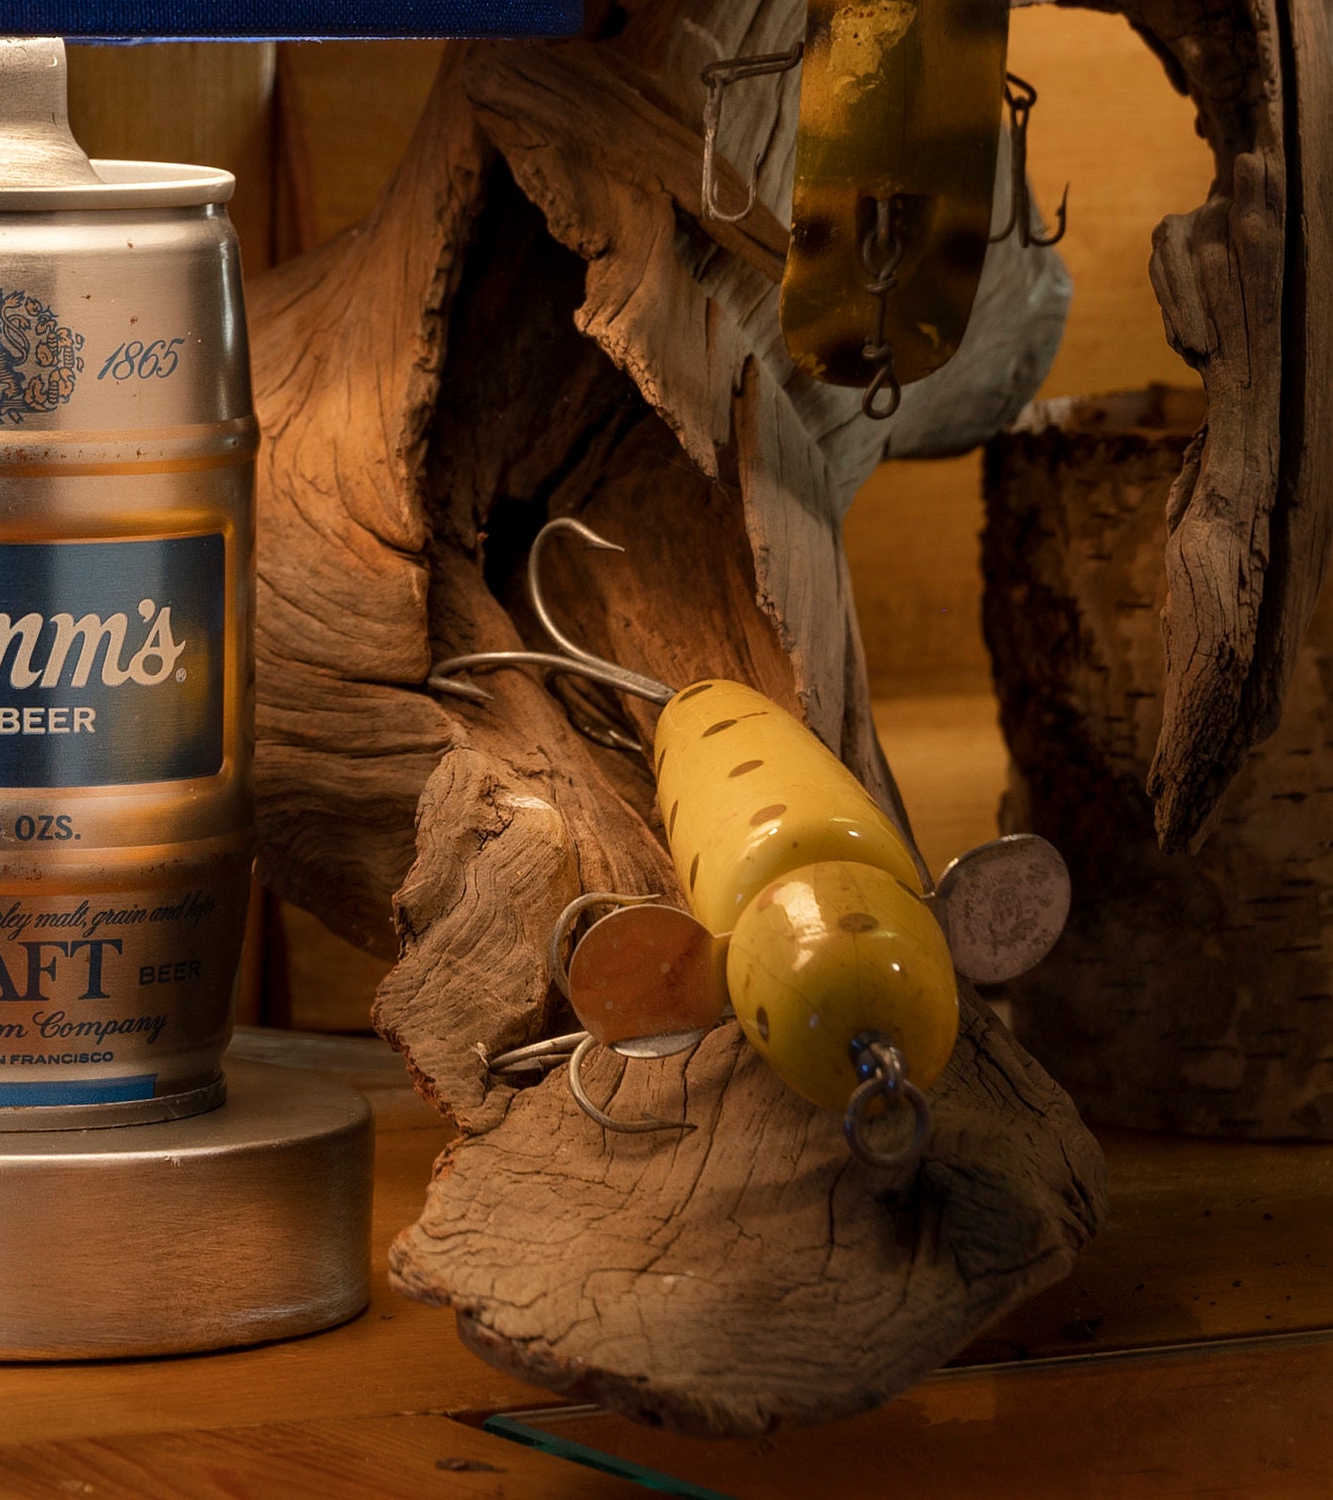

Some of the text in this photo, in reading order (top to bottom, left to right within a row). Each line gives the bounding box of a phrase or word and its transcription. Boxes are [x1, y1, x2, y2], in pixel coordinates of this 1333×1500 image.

[97, 338, 186, 381] 1865
[15, 815, 81, 842] OZS.
[33, 900, 89, 928] malt,
[82, 904, 147, 938] grain
[138, 959, 204, 986] BEER
[32, 1011, 169, 1046] Company
[9, 1051, 114, 1066] FRANCISCO
